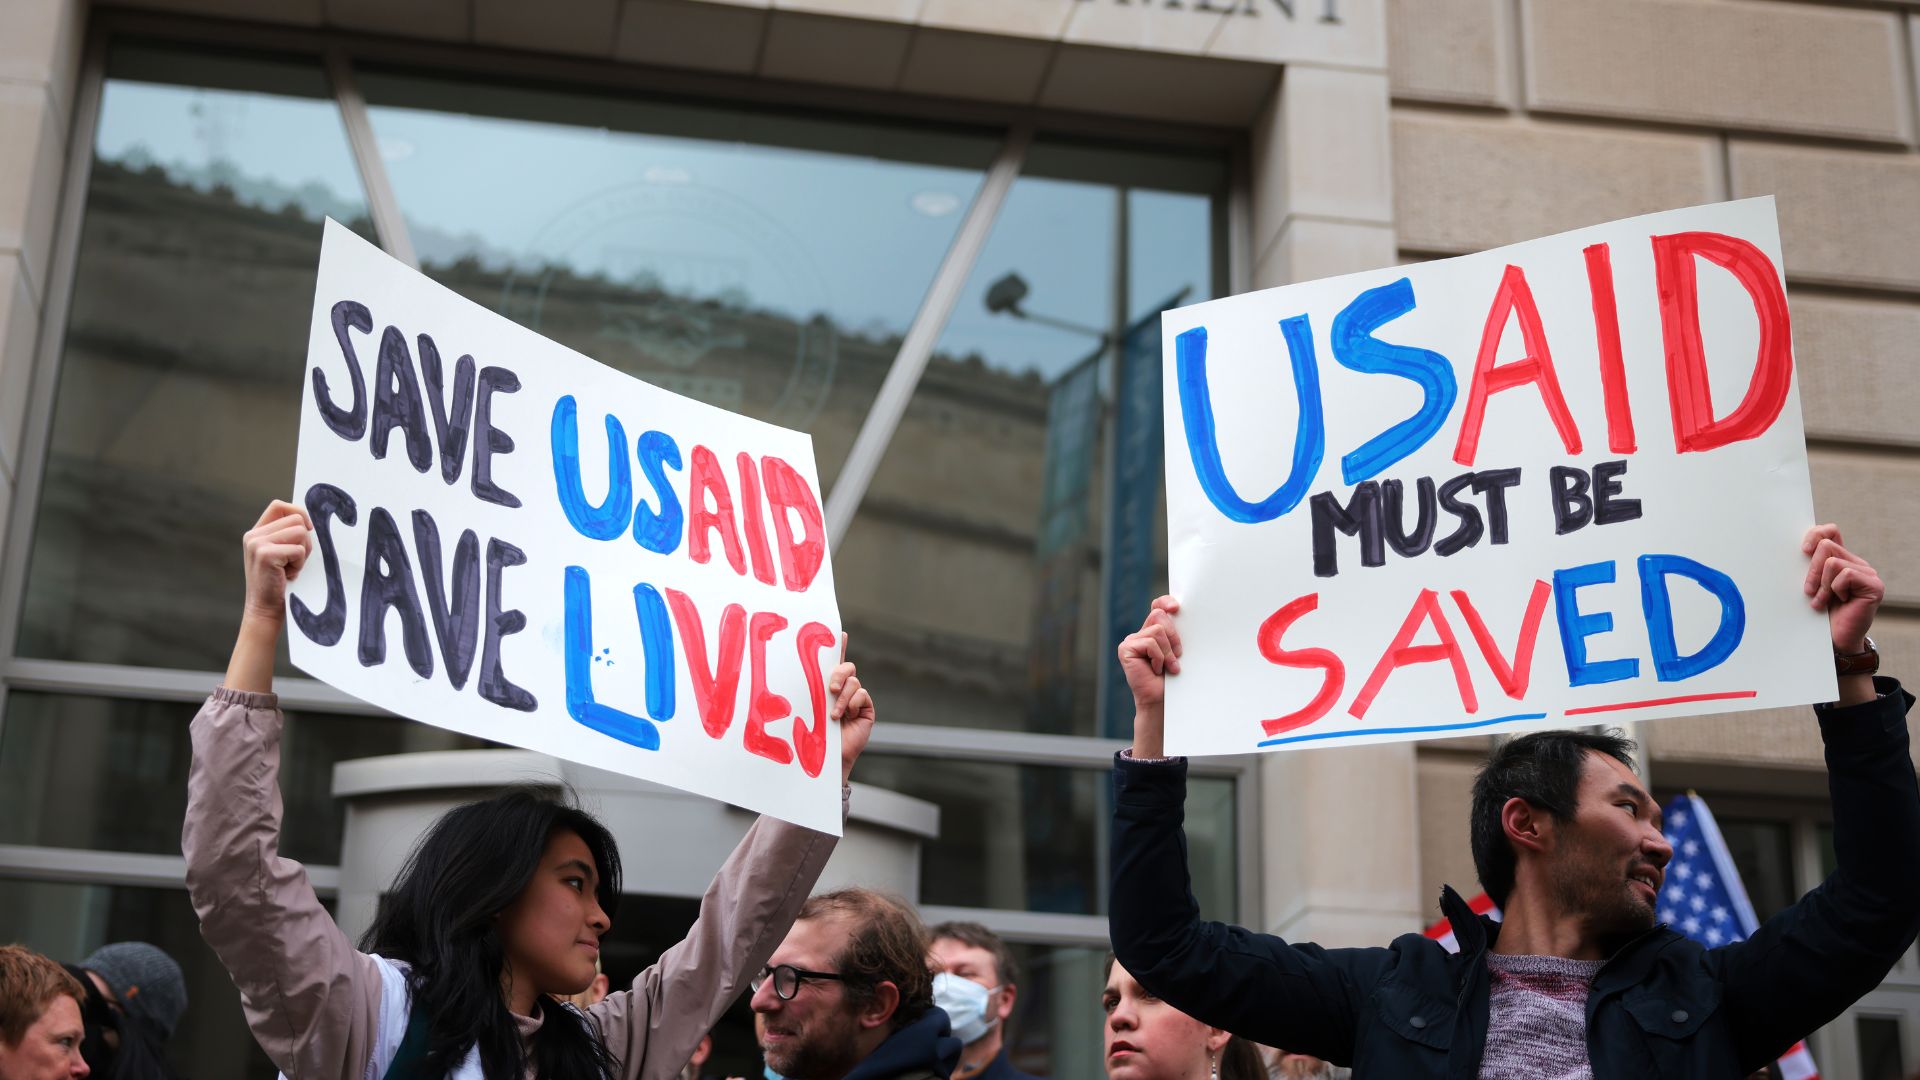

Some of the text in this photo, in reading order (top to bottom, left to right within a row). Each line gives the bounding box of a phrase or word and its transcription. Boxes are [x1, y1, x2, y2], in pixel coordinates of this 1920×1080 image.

[312, 300, 825, 593] SAVE USAID
[1175, 231, 1794, 524] USAID
[1309, 459, 1642, 578] MUST BE
[289, 483, 836, 778] SAVE LIVES
[1257, 553, 1746, 737] SAVED
